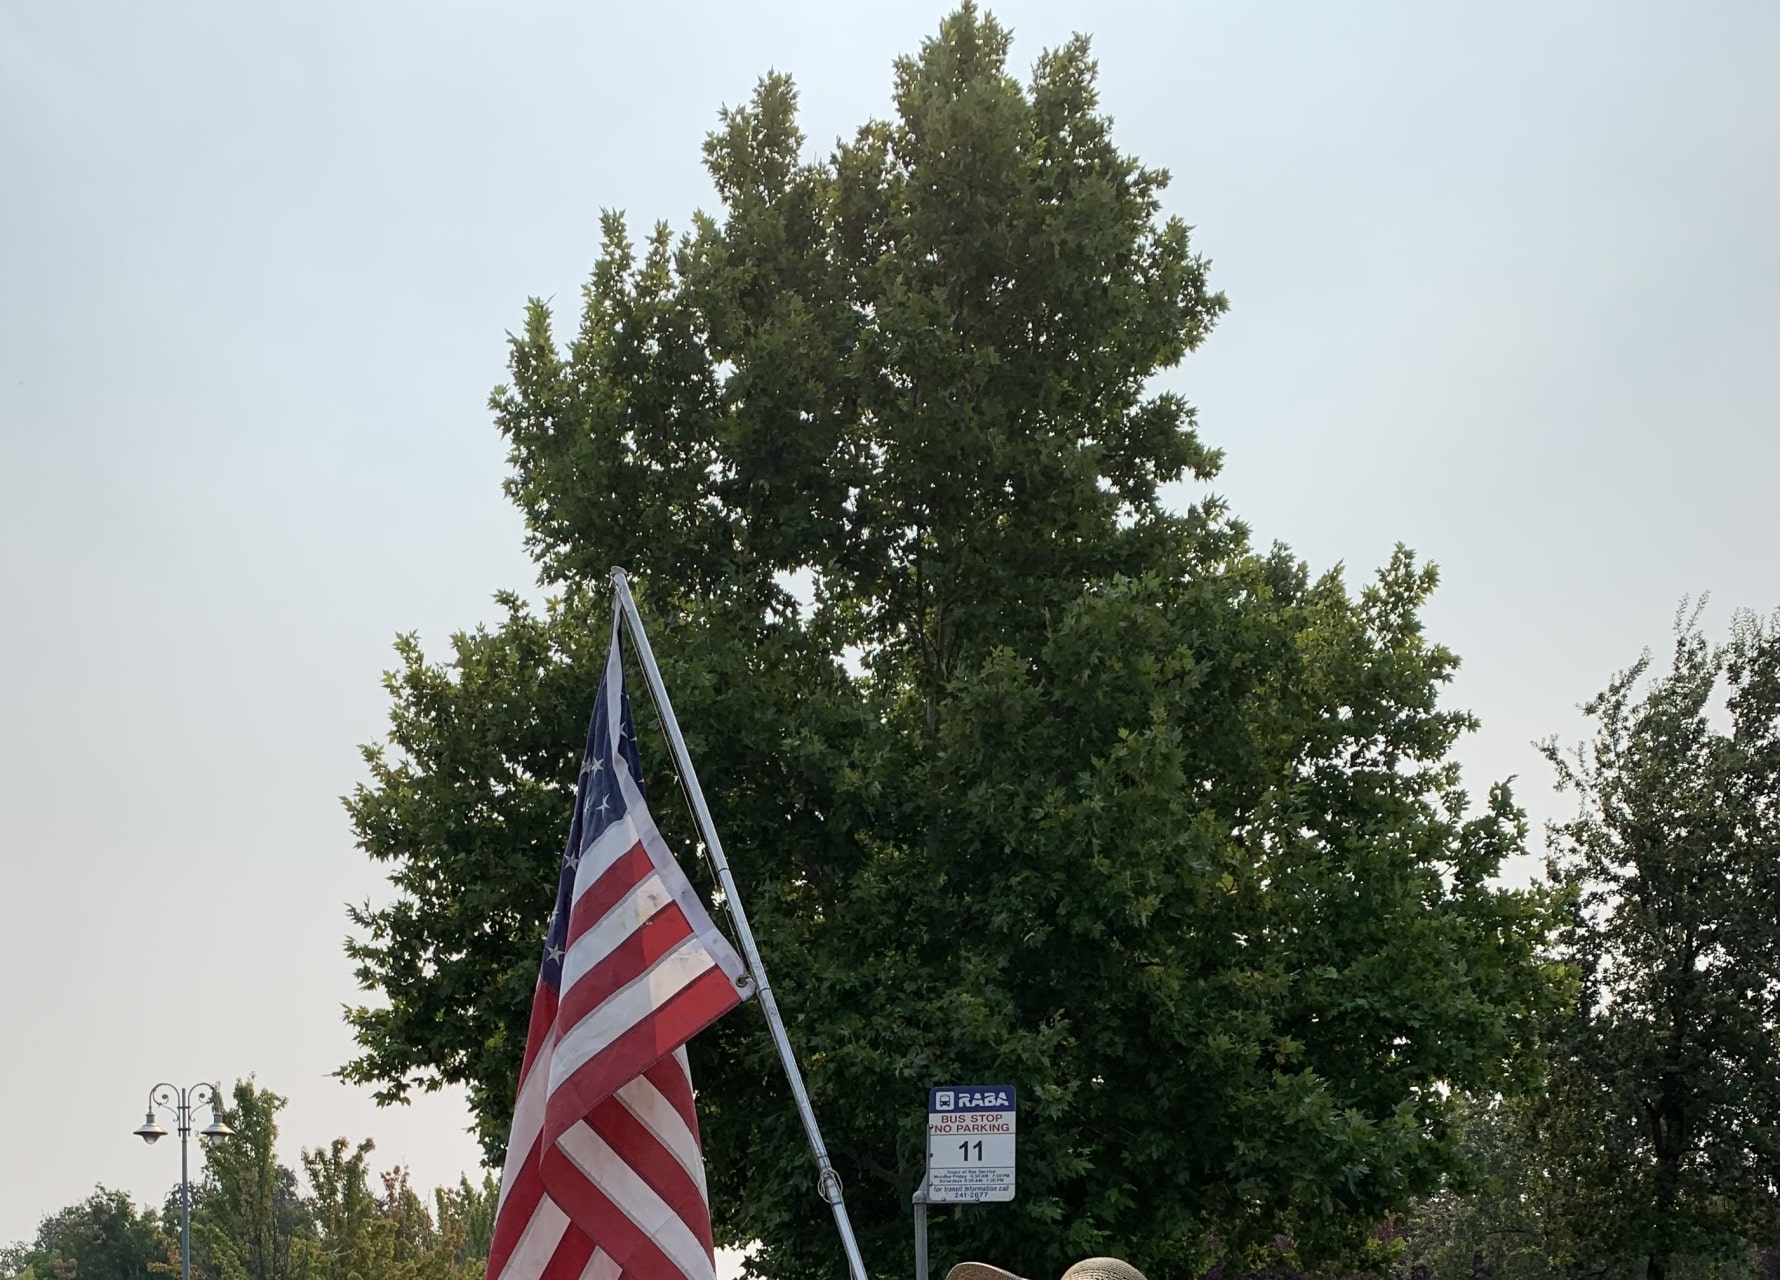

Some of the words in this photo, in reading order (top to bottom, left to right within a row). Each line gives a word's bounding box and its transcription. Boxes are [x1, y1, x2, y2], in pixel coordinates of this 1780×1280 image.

[958, 1092, 1009, 1107] RABA
[941, 1115, 966, 1123] BUS
[970, 1114, 1003, 1123] STOP
[934, 1125, 952, 1133] NO
[956, 1123, 1010, 1133] PARKING
[959, 1140, 983, 1161] 11
